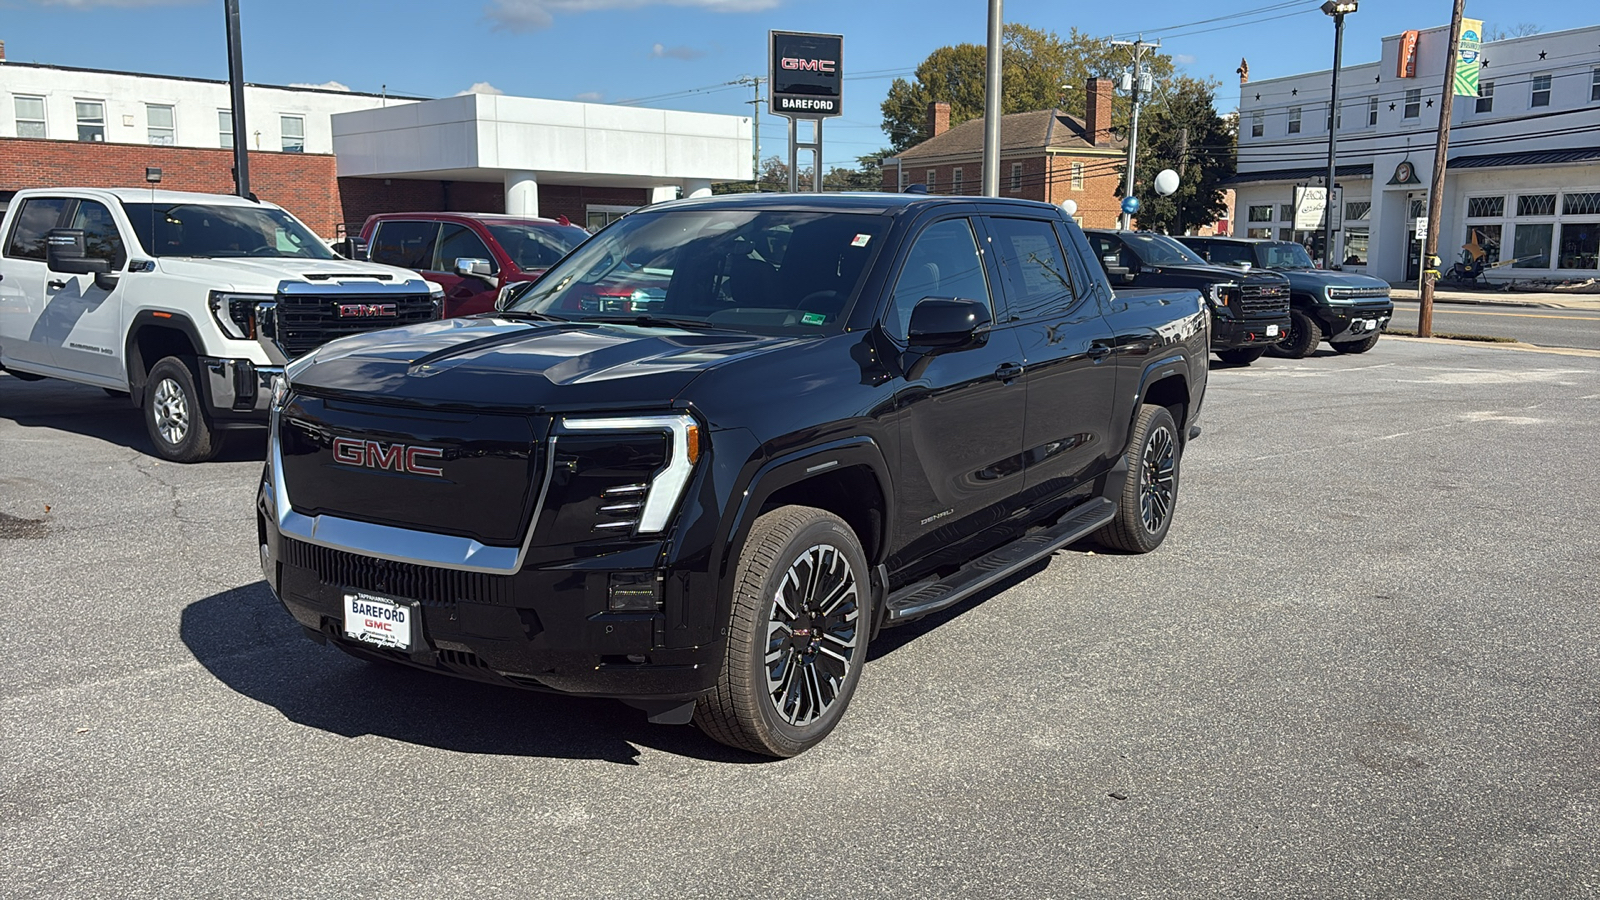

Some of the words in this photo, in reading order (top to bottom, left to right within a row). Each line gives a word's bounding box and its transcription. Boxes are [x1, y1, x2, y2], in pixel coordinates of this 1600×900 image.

[1406, 33, 1416, 74] ACME
[781, 57, 836, 72] GMC
[782, 98, 834, 110] BAREFORD
[340, 303, 397, 318] GMC
[333, 436, 444, 477] GMC
[920, 508, 954, 526] DENALI
[352, 601, 405, 623] BAREFORD
[364, 618, 393, 632] GMC
